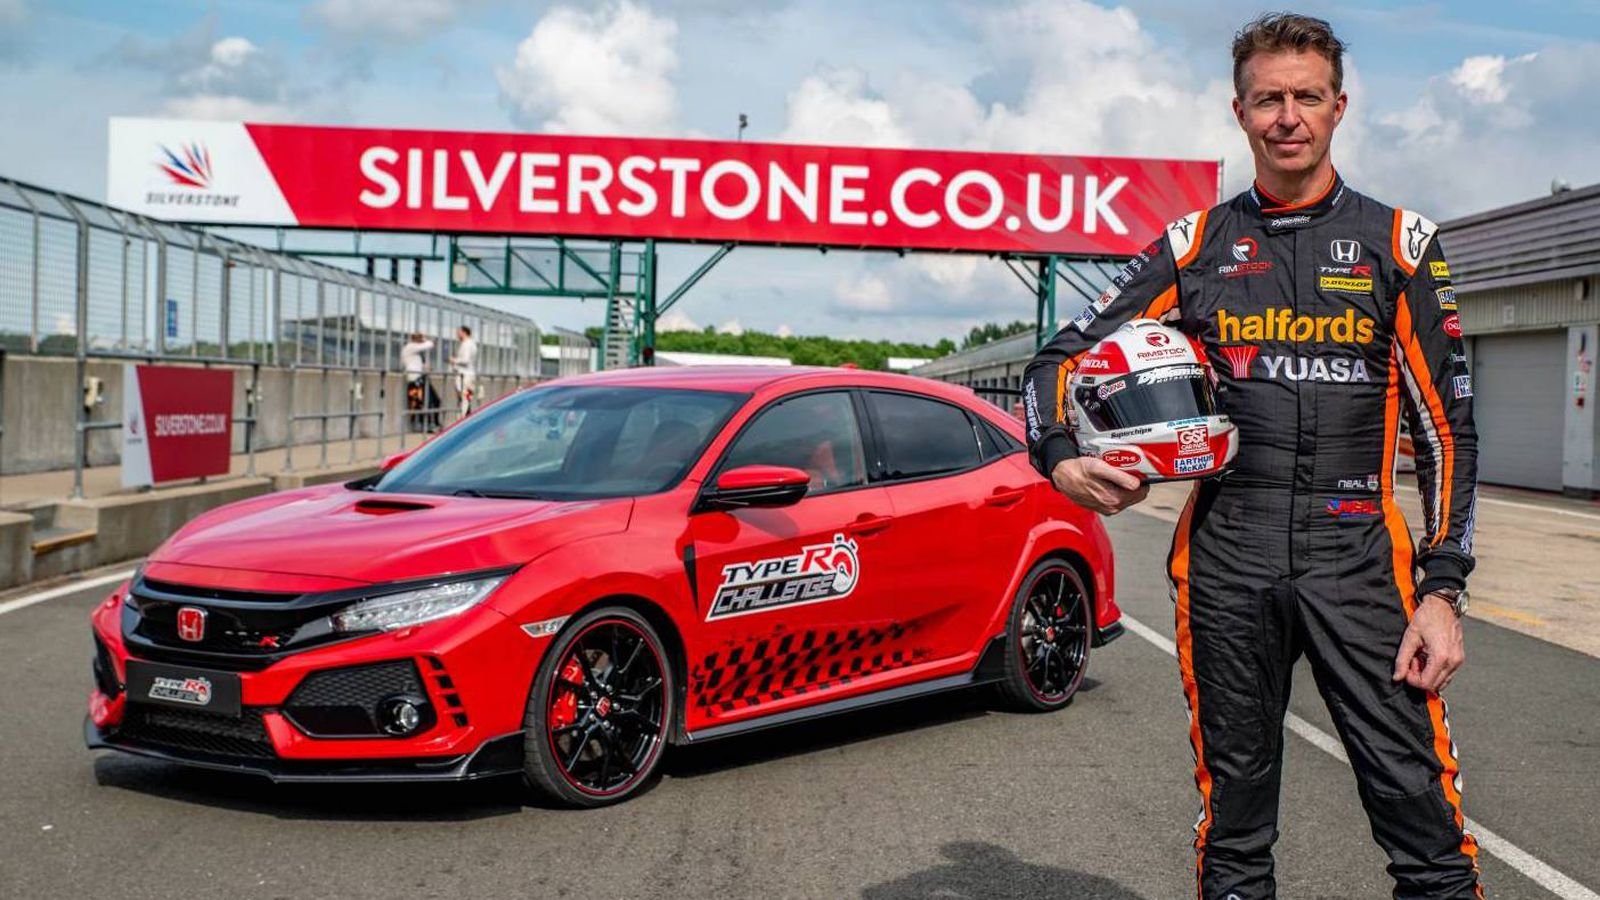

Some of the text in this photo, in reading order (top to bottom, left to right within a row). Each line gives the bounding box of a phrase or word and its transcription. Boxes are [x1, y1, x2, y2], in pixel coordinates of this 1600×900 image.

[358, 145, 1130, 236] SILVERSTONE.CO.UK
[145, 191, 240, 208] SILVERSTONE
[1319, 265, 1352, 275] TYPE
[1330, 279, 1371, 289] DUNLOP
[1217, 307, 1375, 345] halfords
[1137, 347, 1188, 360] RIMSTOCK
[1261, 355, 1371, 384] YUASA
[1110, 427, 1152, 439] Superchips
[1180, 428, 1207, 445] GSF
[1105, 455, 1136, 463] DELPHI
[1180, 455, 1214, 466] ARTHUR
[1179, 462, 1208, 473] McKAY
[725, 545, 834, 584] TYPE R
[713, 573, 836, 613] CHALLENGE
